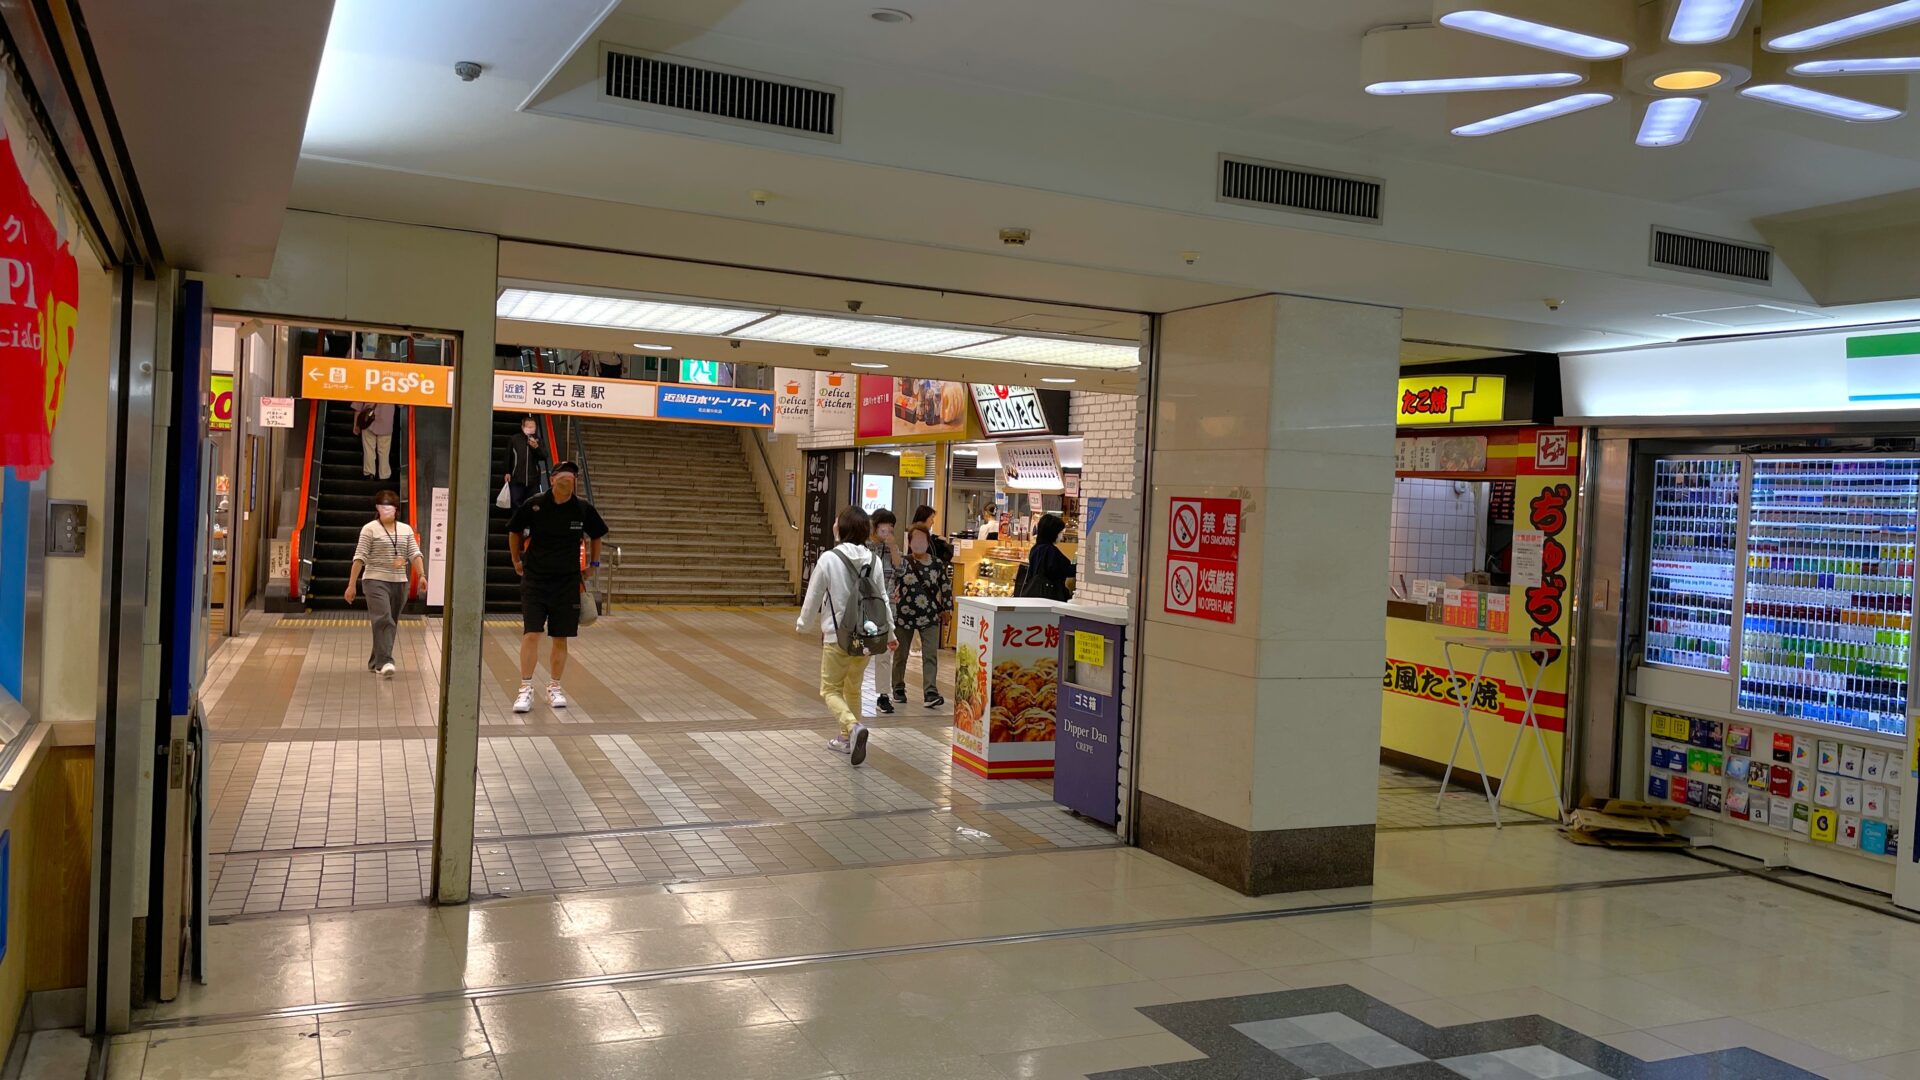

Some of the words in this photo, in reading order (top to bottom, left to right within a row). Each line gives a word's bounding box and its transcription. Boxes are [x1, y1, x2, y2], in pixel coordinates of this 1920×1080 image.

[532, 381, 605, 400] 名古屋駅
[819, 387, 850, 398] Delica
[533, 397, 568, 408] Nagoya
[571, 399, 603, 409] Station
[663, 393, 758, 408] 近畿日本ツーリスト
[779, 396, 807, 405] Delica
[816, 398, 852, 409] Kitchen
[1402, 386, 1448, 414] たこ焼
[776, 405, 809, 415] Kitchen
[982, 399, 1041, 428] にぎりたて
[1202, 512, 1237, 535] 禁煙
[1201, 535, 1210, 544] NO
[1210, 536, 1236, 546] SMOKING
[1198, 568, 1235, 596] 火気厳禁
[1198, 597, 1204, 609] NO
[1204, 598, 1218, 612] OPEN
[1218, 600, 1233, 614] FLAME
[1075, 693, 1097, 711] ゴミ箱
[1064, 718, 1089, 738] Dipper
[1091, 726, 1108, 743] Dan
